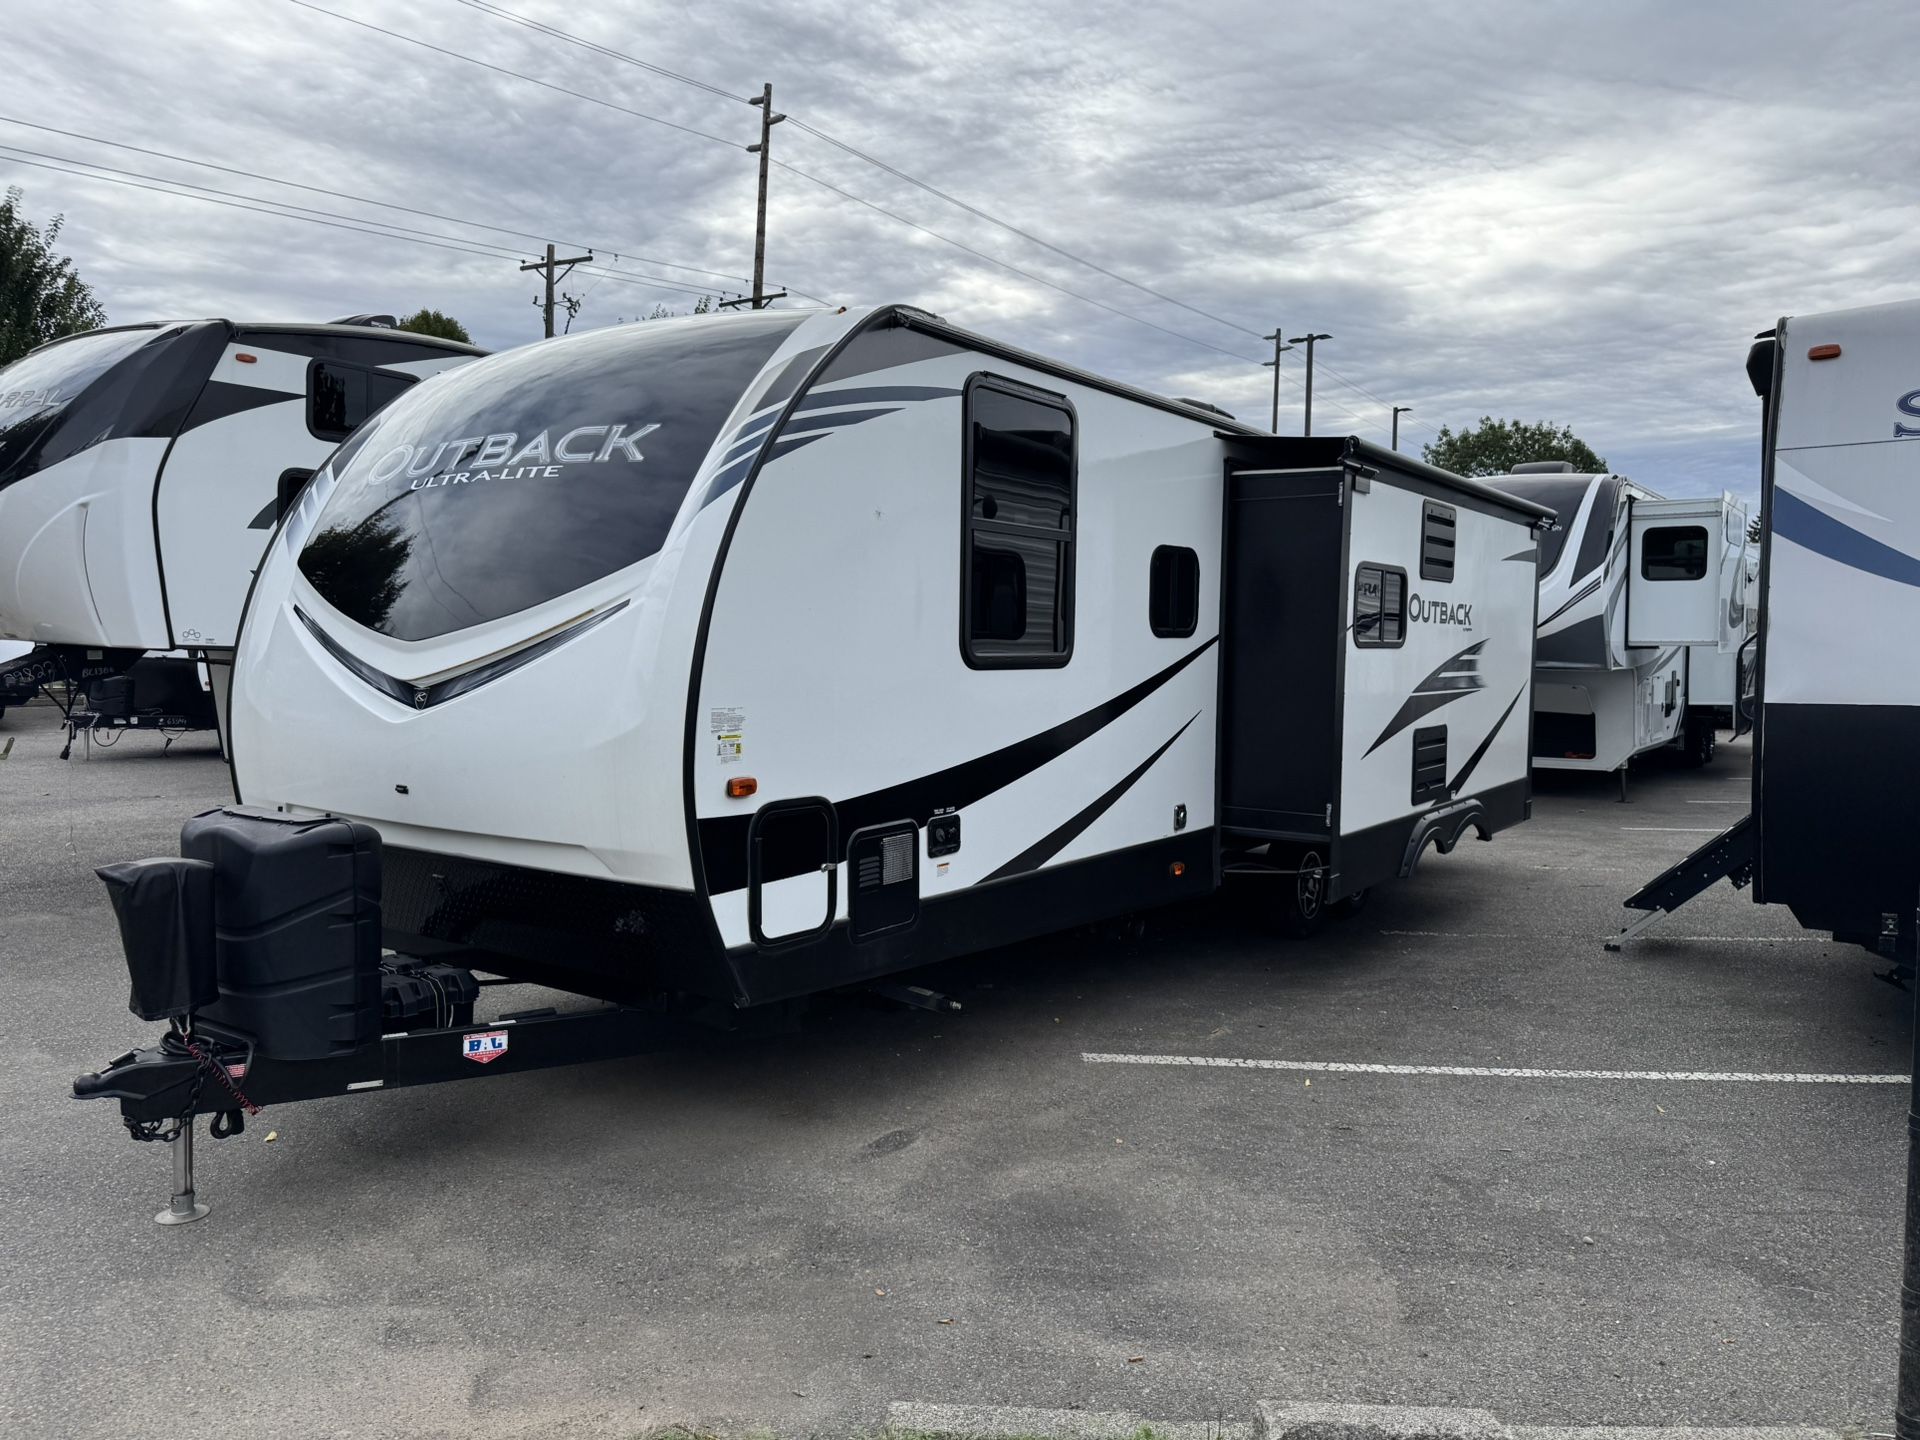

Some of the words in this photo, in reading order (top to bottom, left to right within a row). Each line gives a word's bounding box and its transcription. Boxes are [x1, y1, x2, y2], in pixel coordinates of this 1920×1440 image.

[368, 423, 662, 485] OUTBACK
[410, 465, 564, 491] ULTRA-LITE
[1408, 593, 1473, 626] OUTBACK
